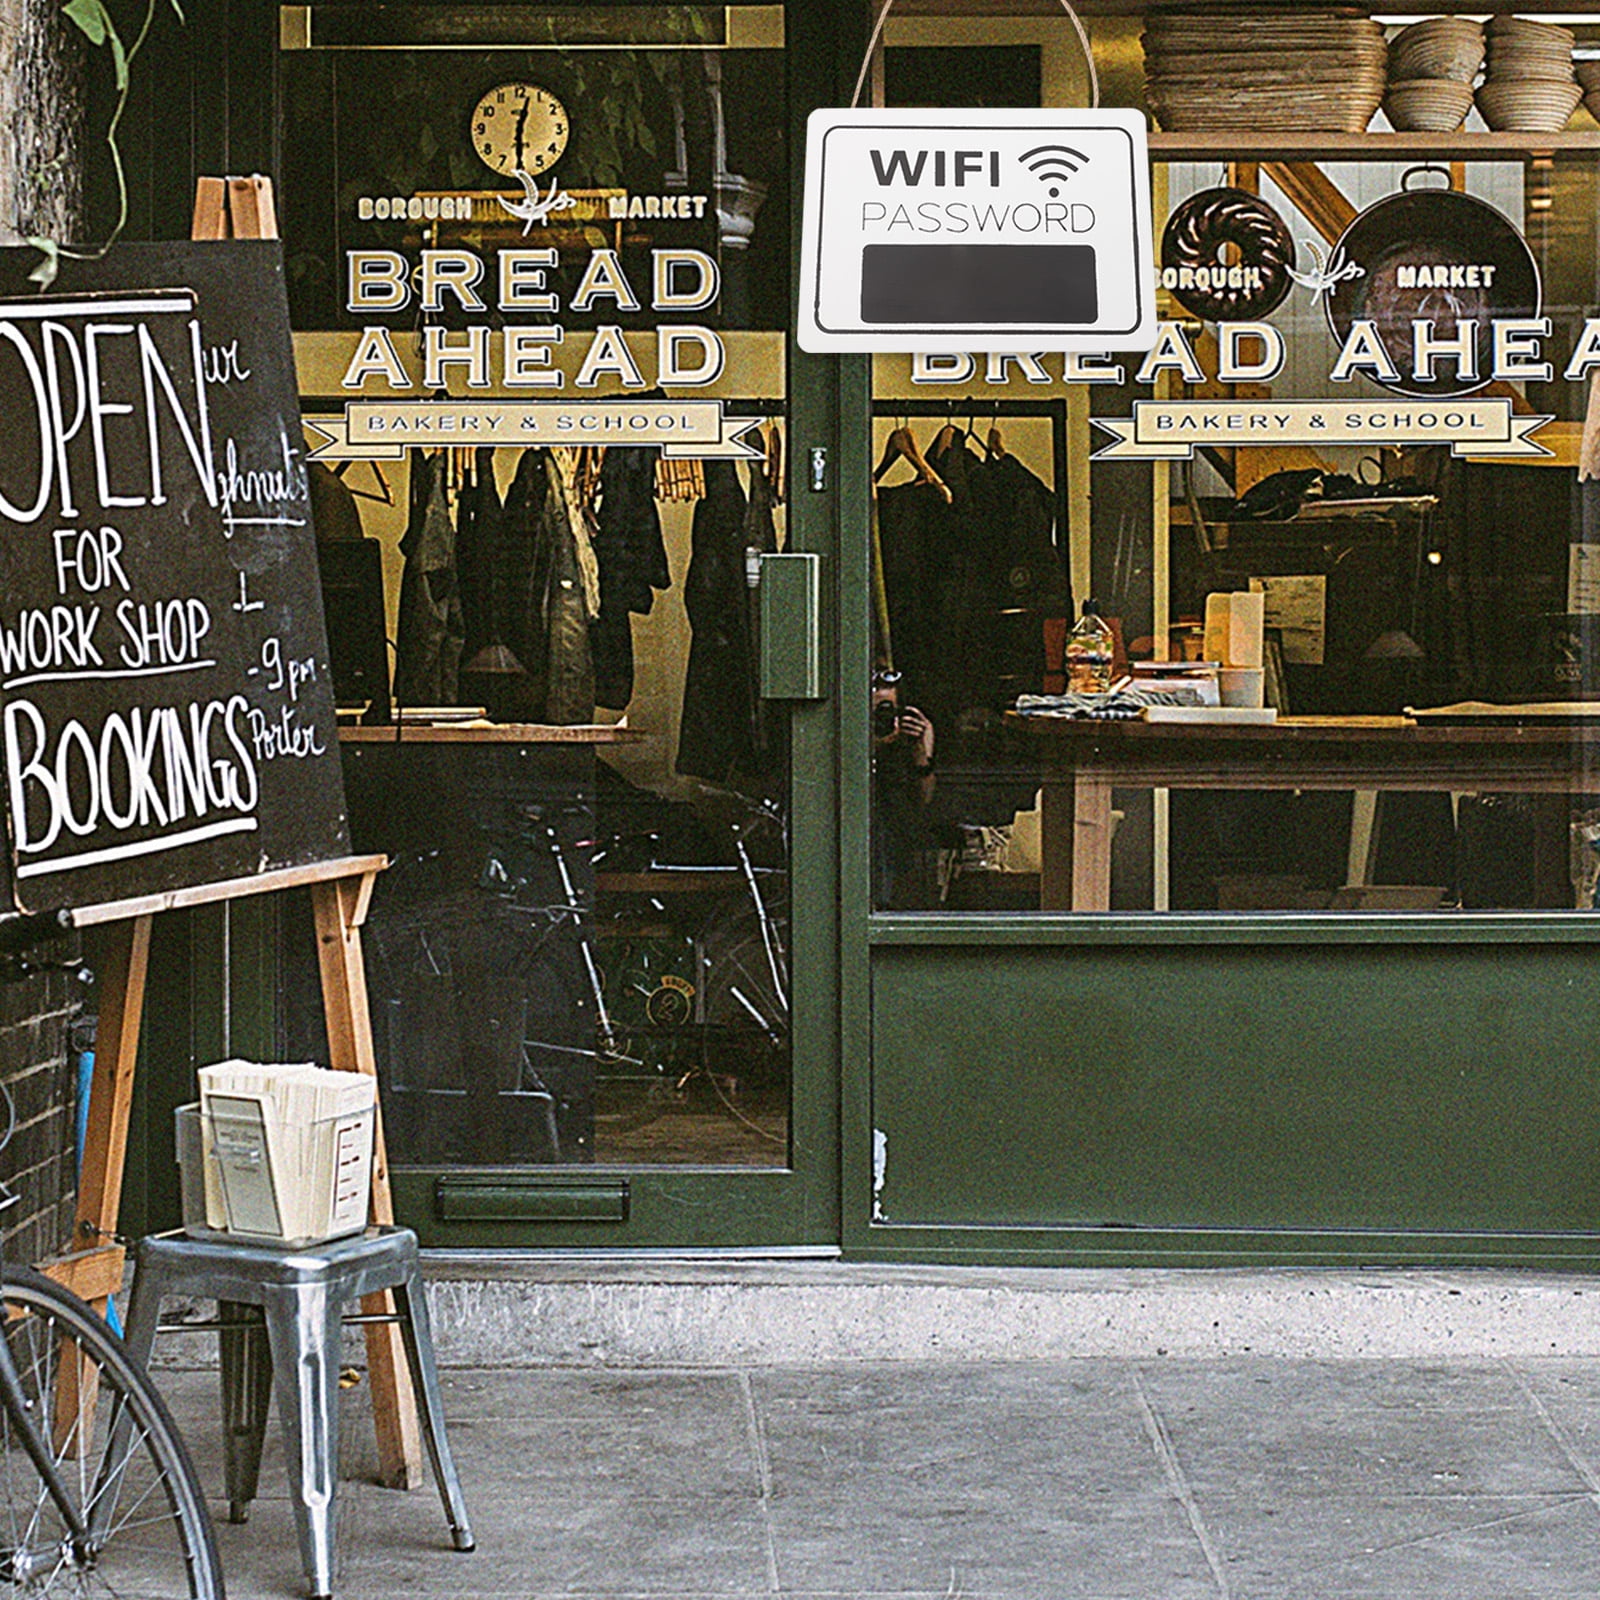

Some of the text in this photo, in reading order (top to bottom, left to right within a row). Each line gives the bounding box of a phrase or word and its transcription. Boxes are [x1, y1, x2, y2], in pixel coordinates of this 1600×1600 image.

[496, 92, 505, 104] 11
[514, 87, 525, 98] 12
[536, 91, 542, 103] 1
[483, 105, 495, 117] 10
[549, 103, 557, 115] 2
[477, 122, 486, 135] 9
[555, 123, 564, 135] 3
[483, 143, 492, 155] 8
[548, 142, 557, 154] 4
[499, 154, 507, 167] 7
[535, 154, 544, 167] 5
[869, 149, 1000, 187] WIFI
[358, 195, 708, 220] BOROUGH MARKET
[861, 201, 1096, 233] PASSWORD
[346, 248, 722, 312] BREAD
[1396, 265, 1496, 289] MARKET
[341, 324, 726, 389] AHEAD
[0, 319, 219, 522] OPEN
[368, 413, 696, 431] BAKERY & SCHOOL
[1156, 412, 1485, 430] BAKERY & SCHOOL
[53, 526, 131, 594] FOR
[0, 598, 210, 674] WORK SHOP
[246, 705, 326, 760] Porter
[4, 695, 259, 853] BOOKINGS
